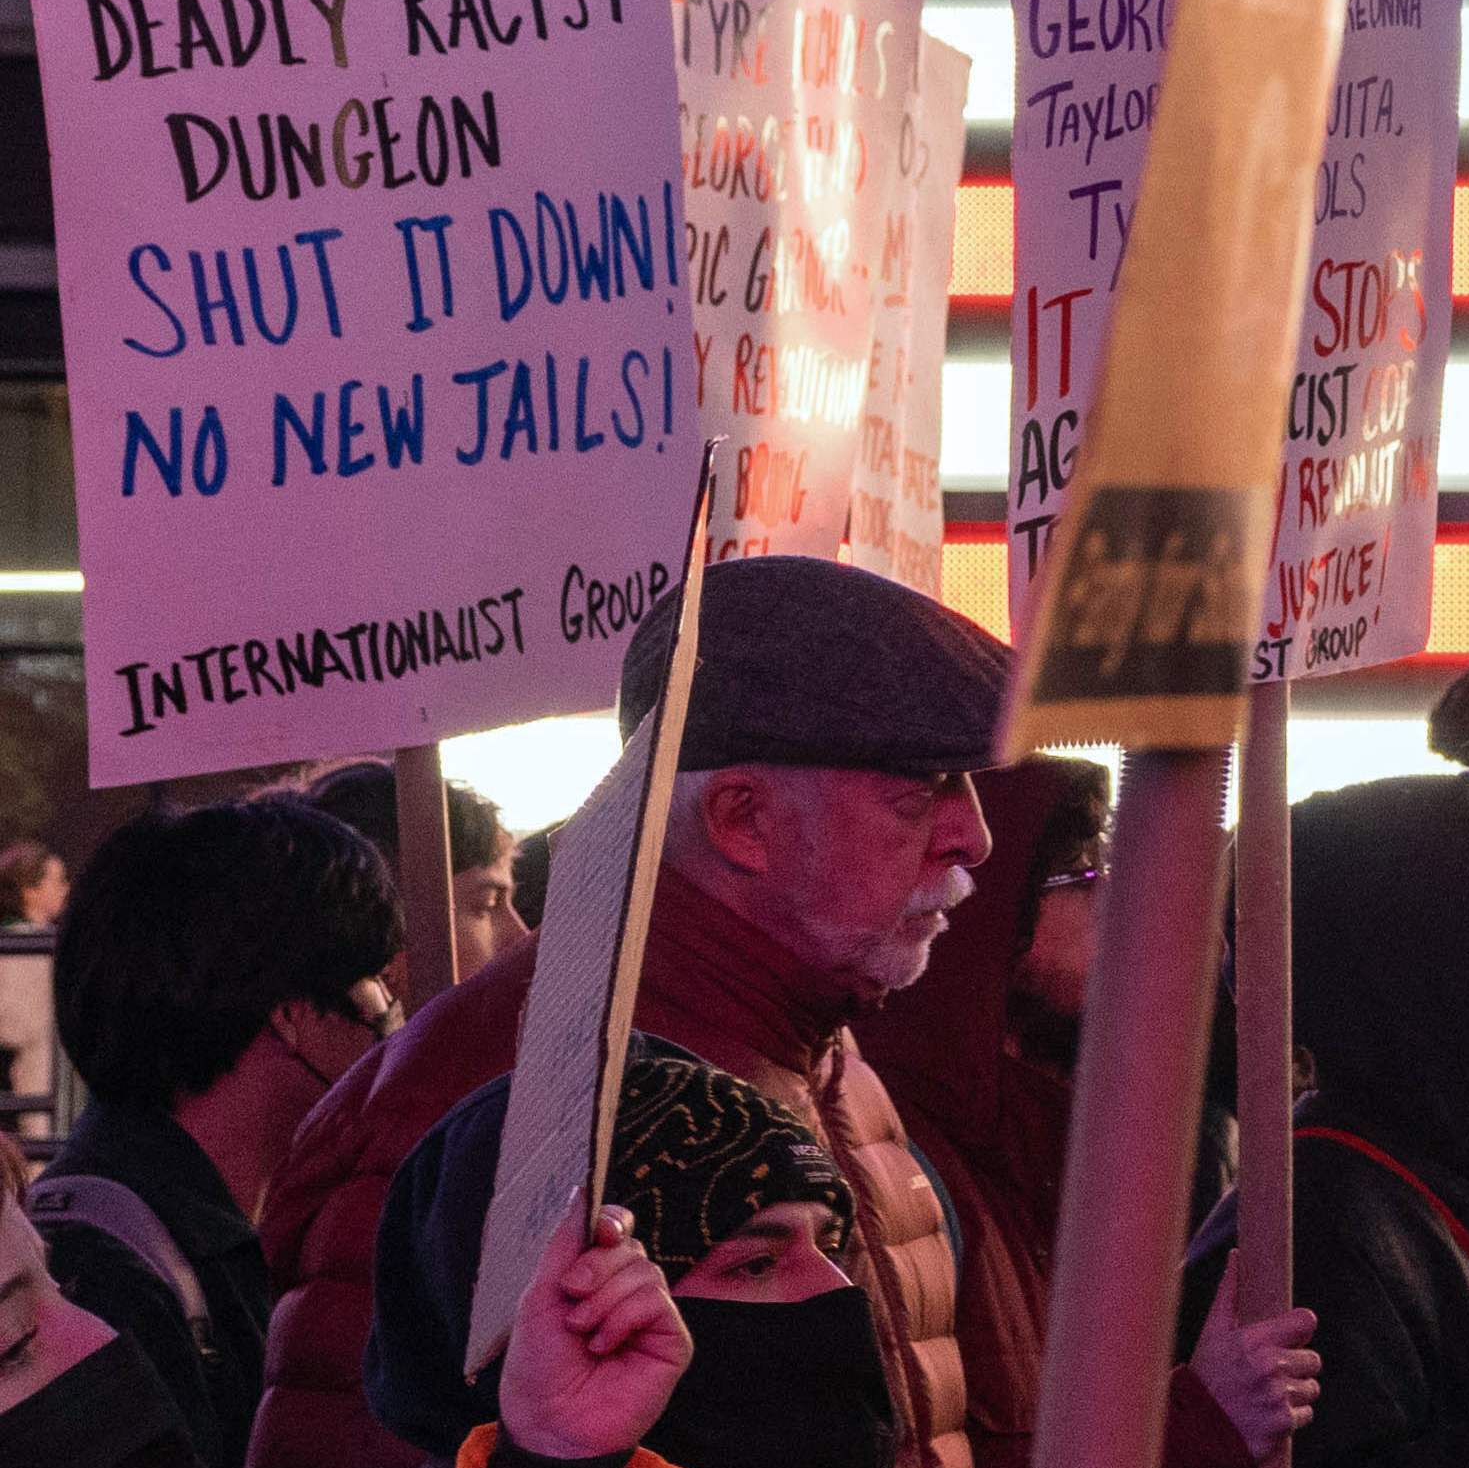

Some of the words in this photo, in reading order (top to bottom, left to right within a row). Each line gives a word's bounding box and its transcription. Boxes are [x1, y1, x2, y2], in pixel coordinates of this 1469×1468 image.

[165, 91, 502, 204] DUNGEON
[122, 227, 343, 358] SHUT
[394, 215, 456, 332] IT
[489, 181, 680, 323] DOWN!
[1026, 285, 1094, 412] IT
[1287, 363, 1358, 447] CIST
[121, 406, 229, 498] NO
[270, 381, 426, 488] NEW
[451, 345, 676, 465] JAILS!
[116, 587, 526, 737] INTERNATIONALIST
[560, 564, 670, 648] GROUP
